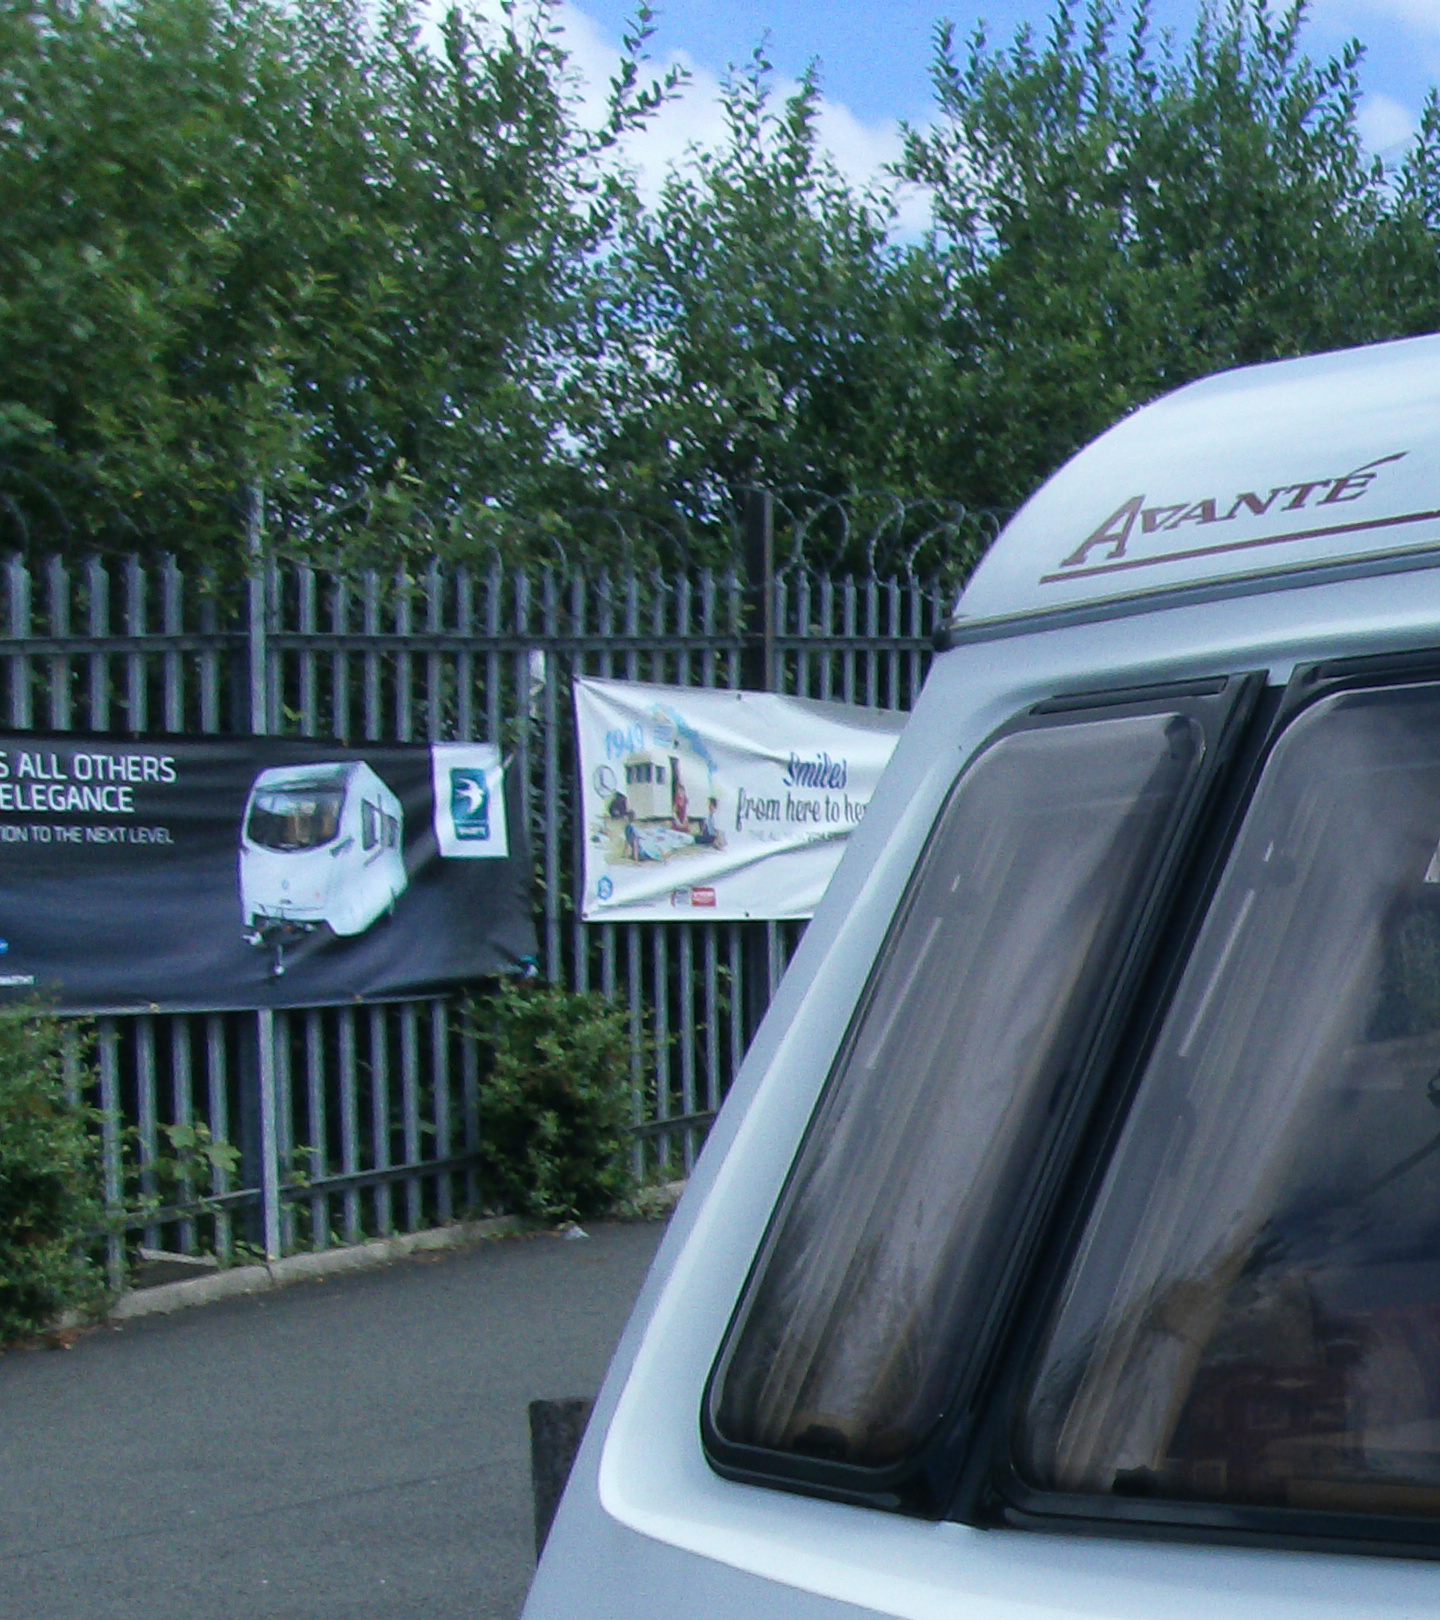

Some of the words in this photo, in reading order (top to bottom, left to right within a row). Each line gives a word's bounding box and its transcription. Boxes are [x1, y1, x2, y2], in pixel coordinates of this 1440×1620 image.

[17, 752, 68, 780] ALL
[73, 754, 178, 783] OTHERS
[782, 751, 847, 789] Smiles
[0, 783, 135, 812] ELEGANCE
[735, 787, 780, 831] from
[786, 791, 821, 823] here
[825, 795, 840, 823] to
[30, 825, 51, 843] TO
[53, 825, 82, 843] THE
[85, 826, 127, 844] NEXT
[129, 827, 175, 844] LEVEL
